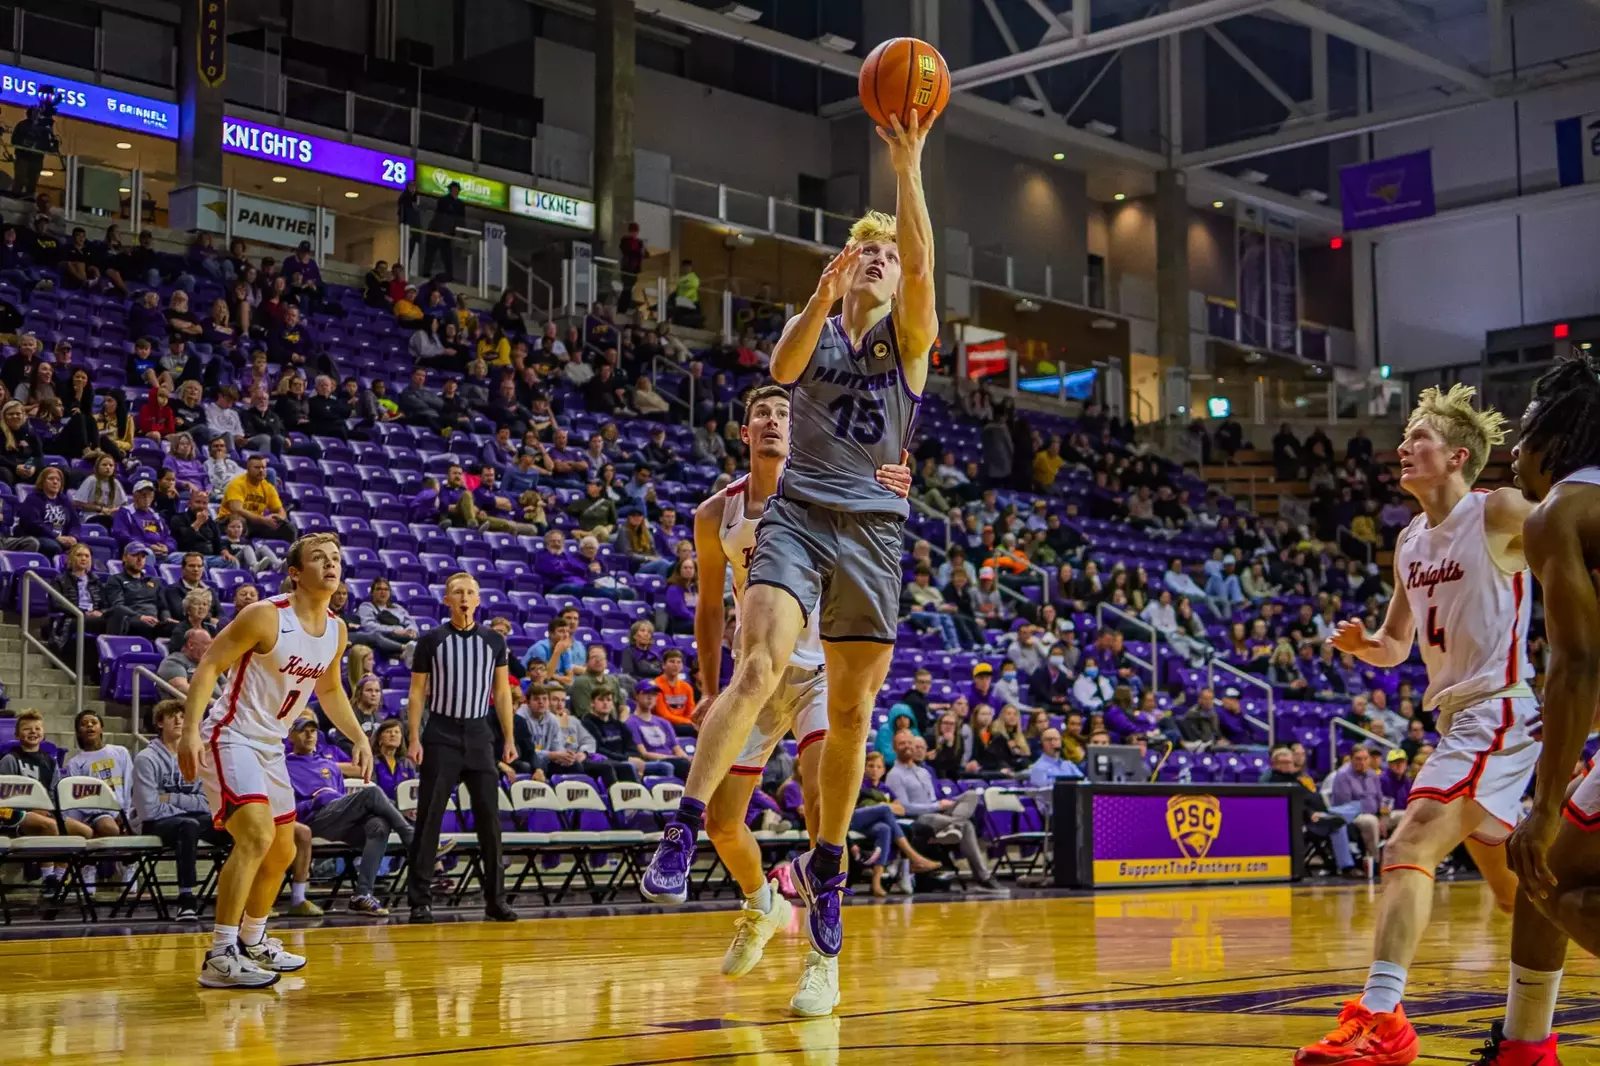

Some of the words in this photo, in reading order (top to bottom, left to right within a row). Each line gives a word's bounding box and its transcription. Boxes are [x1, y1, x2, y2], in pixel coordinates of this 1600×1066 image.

[207, 3, 218, 77] PATIO
[2, 75, 87, 107] BUSESS
[917, 55, 936, 106] ELITE
[119, 104, 168, 123] GRINNELL
[222, 121, 313, 164] KNIGHTS
[381, 159, 407, 184] 28
[436, 171, 491, 196] Vidian
[524, 190, 579, 216] LOCKNET
[486, 227, 503, 240] 107
[828, 394, 885, 445] 15
[1406, 558, 1465, 598] Knights
[1426, 606, 1446, 653] 4
[279, 655, 325, 684] Knight
[277, 689, 301, 720] 0
[0, 783, 34, 799] UNI
[72, 783, 102, 799] UNI
[1174, 804, 1215, 832] PSC
[1119, 861, 1268, 878] SupportThePanthers.com
